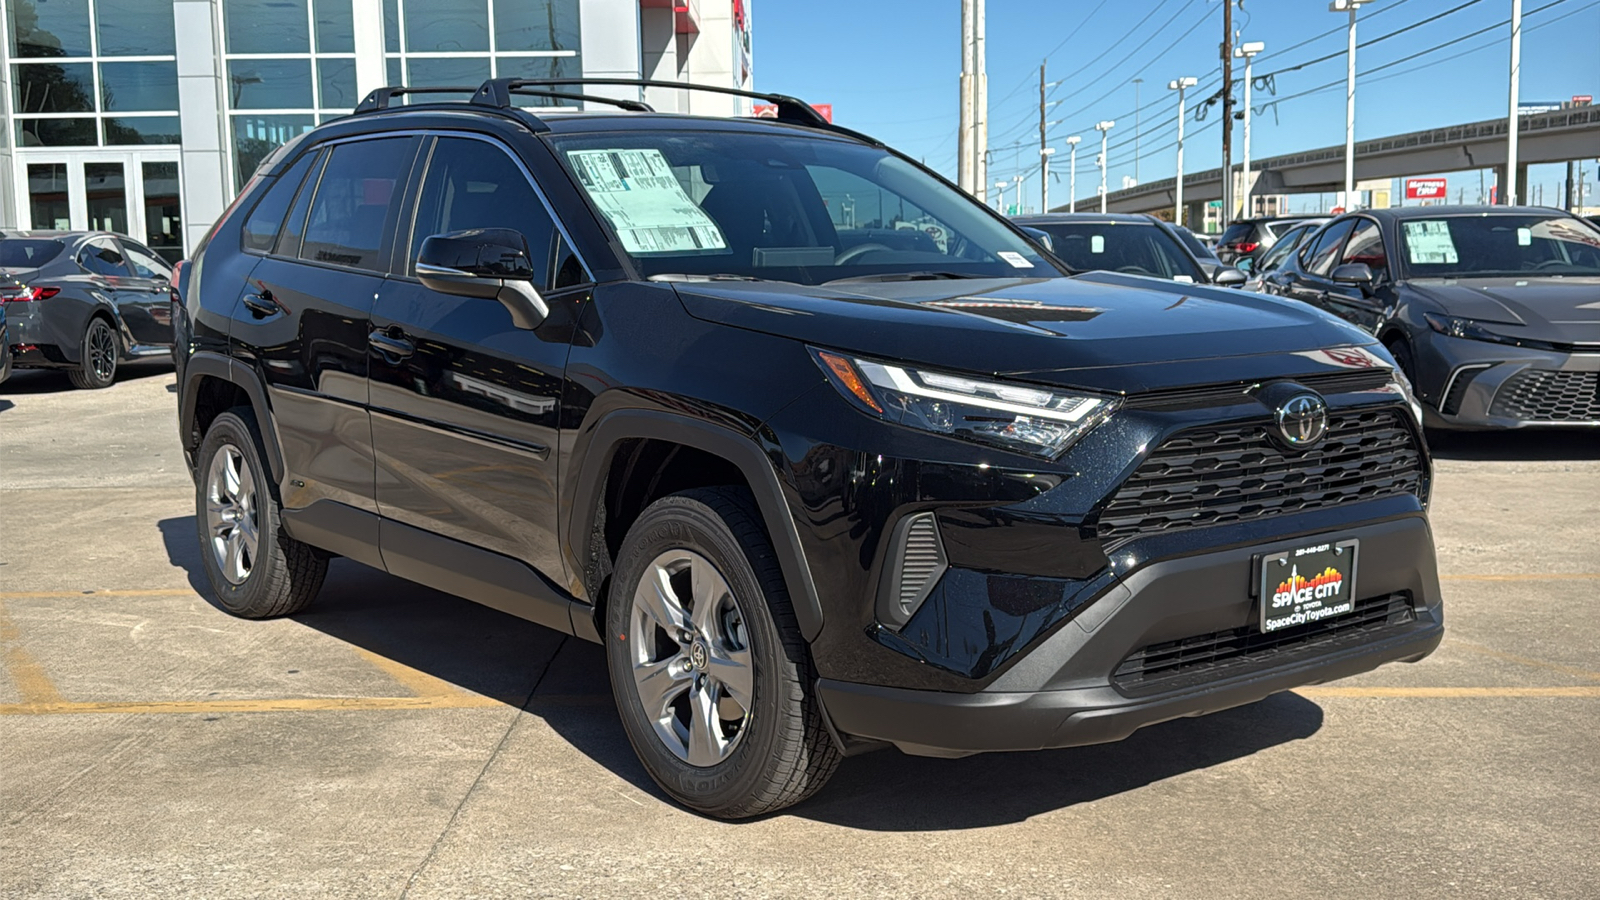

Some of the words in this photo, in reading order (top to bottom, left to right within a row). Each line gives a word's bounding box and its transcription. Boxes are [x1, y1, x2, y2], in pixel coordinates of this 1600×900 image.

[1272, 586, 1313, 608] SPACE
[1315, 580, 1343, 598] CITY
[1302, 601, 1322, 610] TOYOTA
[1266, 603, 1350, 630] SpaceCityToyota.com
